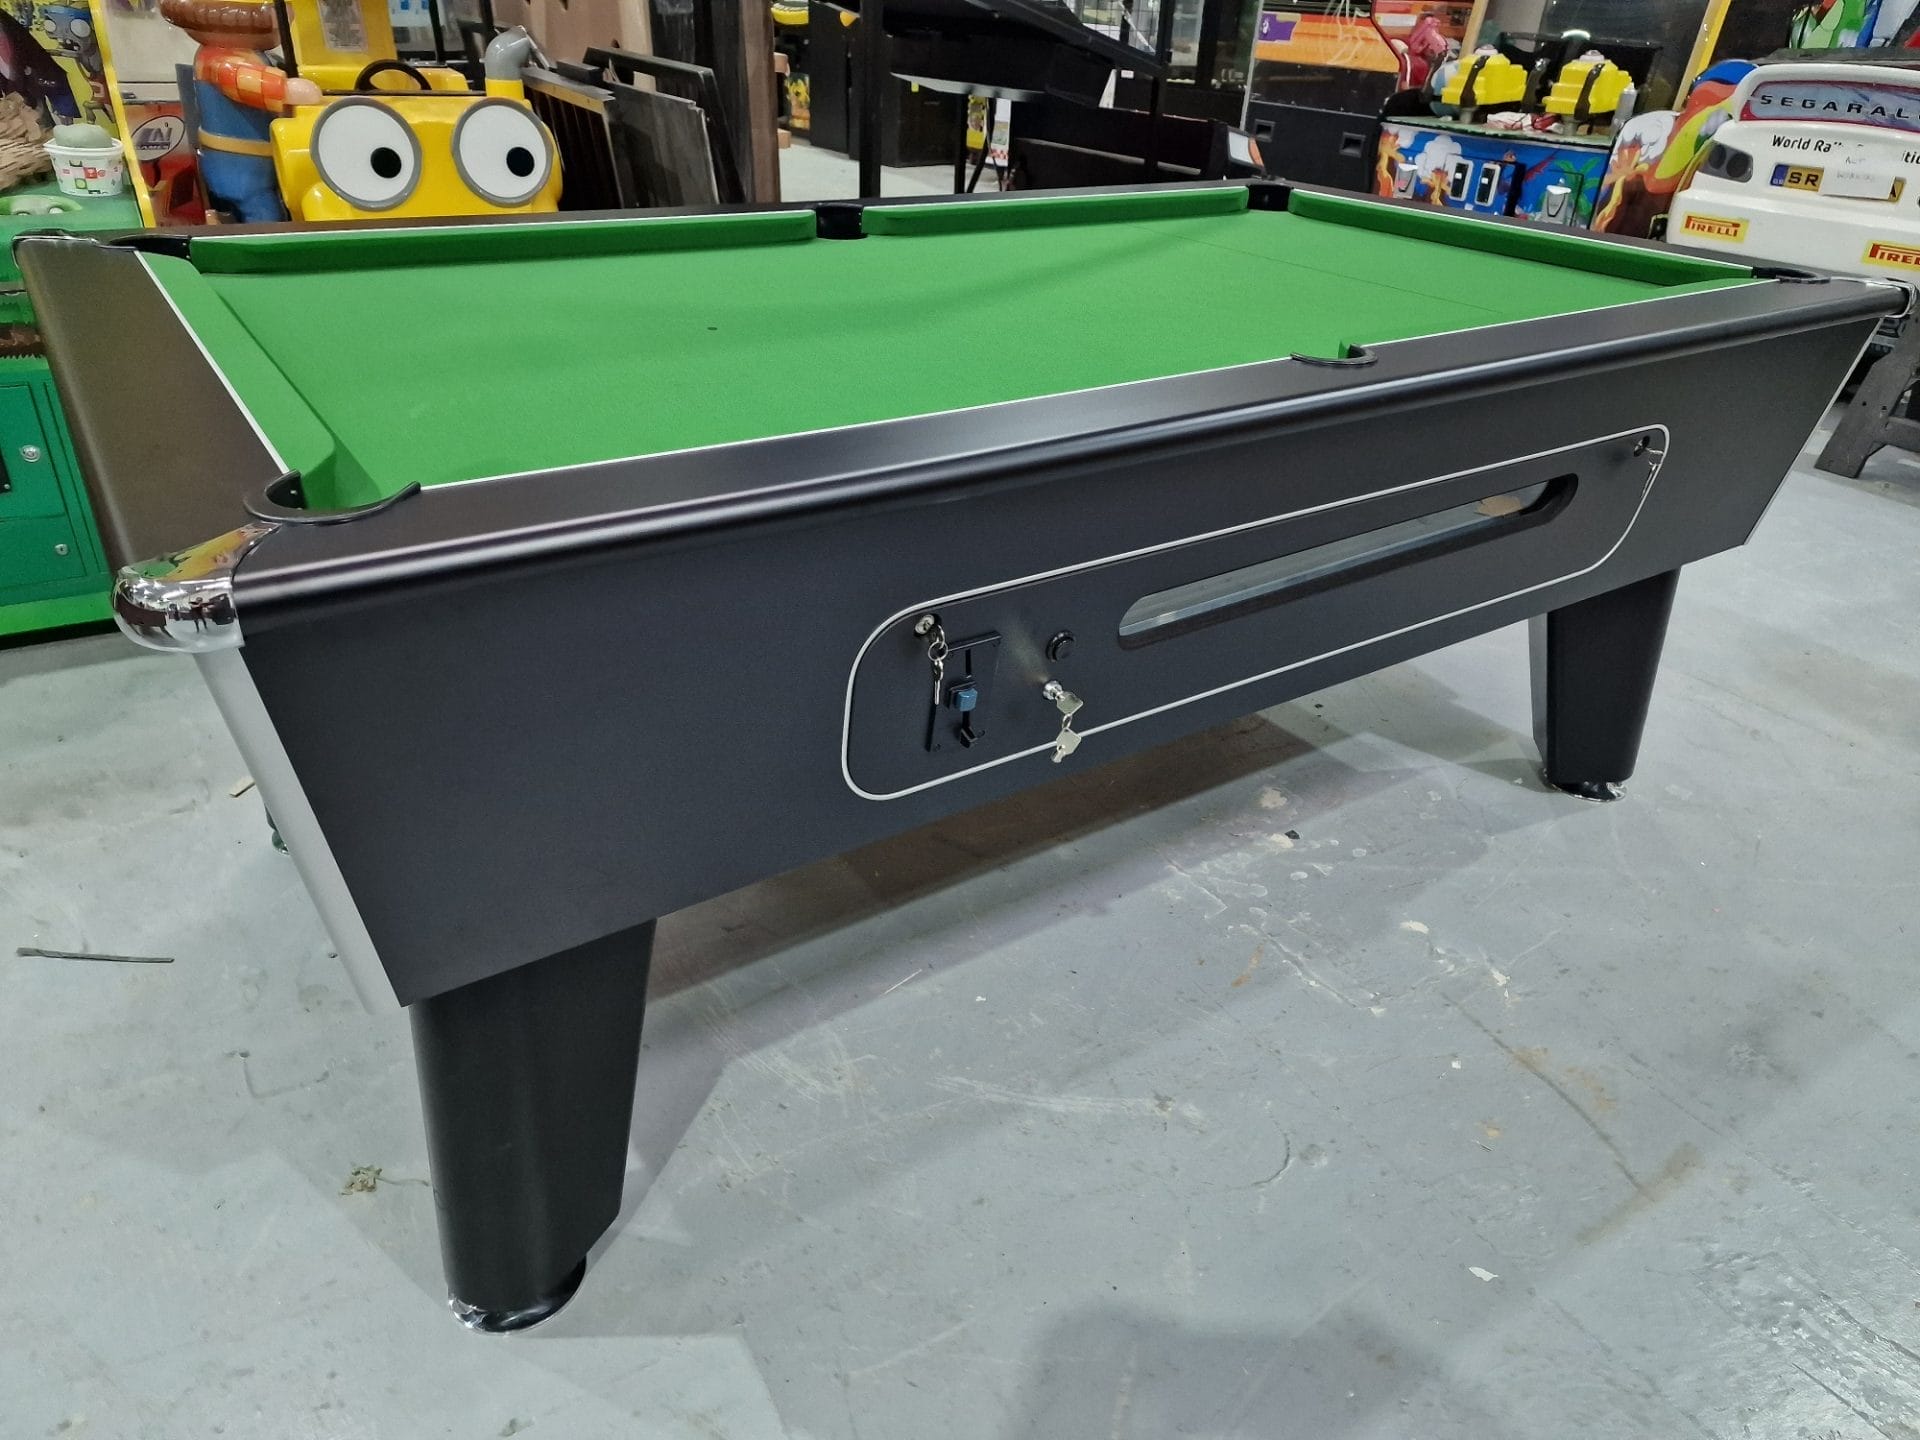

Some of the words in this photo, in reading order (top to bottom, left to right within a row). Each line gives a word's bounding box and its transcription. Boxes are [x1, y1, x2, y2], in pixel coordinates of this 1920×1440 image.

[1760, 94, 1920, 119] SEGARAL
[1772, 135, 1811, 151] World
[1685, 215, 1741, 237] PIRELLI
